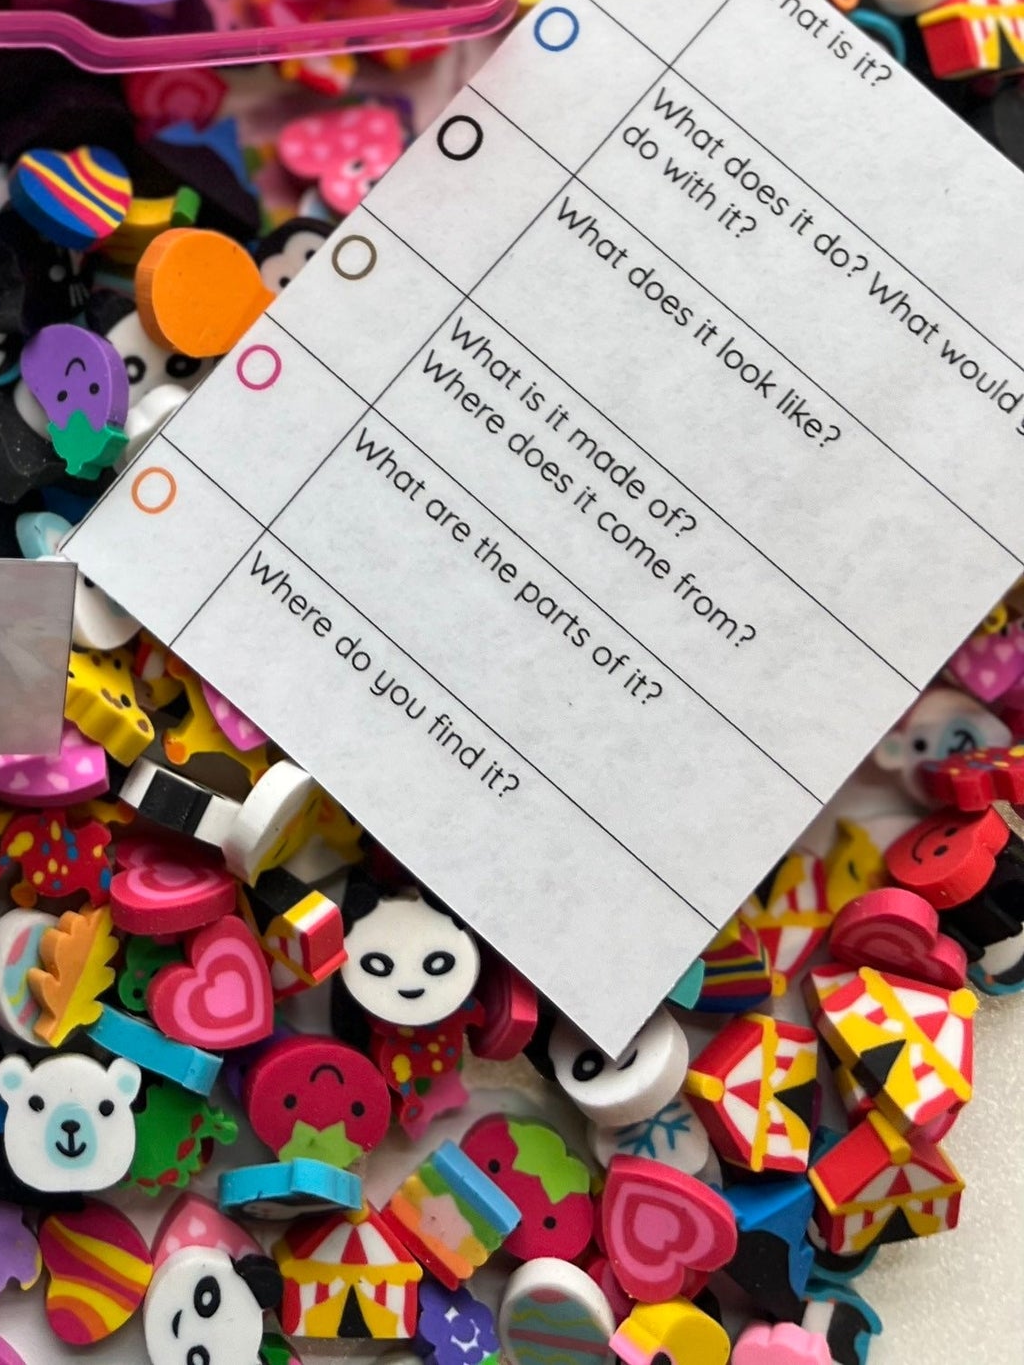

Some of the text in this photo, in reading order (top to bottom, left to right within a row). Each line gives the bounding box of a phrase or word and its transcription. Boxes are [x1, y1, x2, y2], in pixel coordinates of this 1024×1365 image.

[622, 126, 757, 239] do with it?
[826, 30, 853, 60] is
[853, 52, 893, 87] it?
[556, 196, 842, 448] What does it look like?
[653, 86, 1024, 415] What does it do? What would
[422, 348, 757, 648] Where does it come from?
[450, 315, 698, 538] What is it made of?
[250, 549, 521, 798] Where do you find it?
[354, 426, 663, 705] What are the parts of it?
